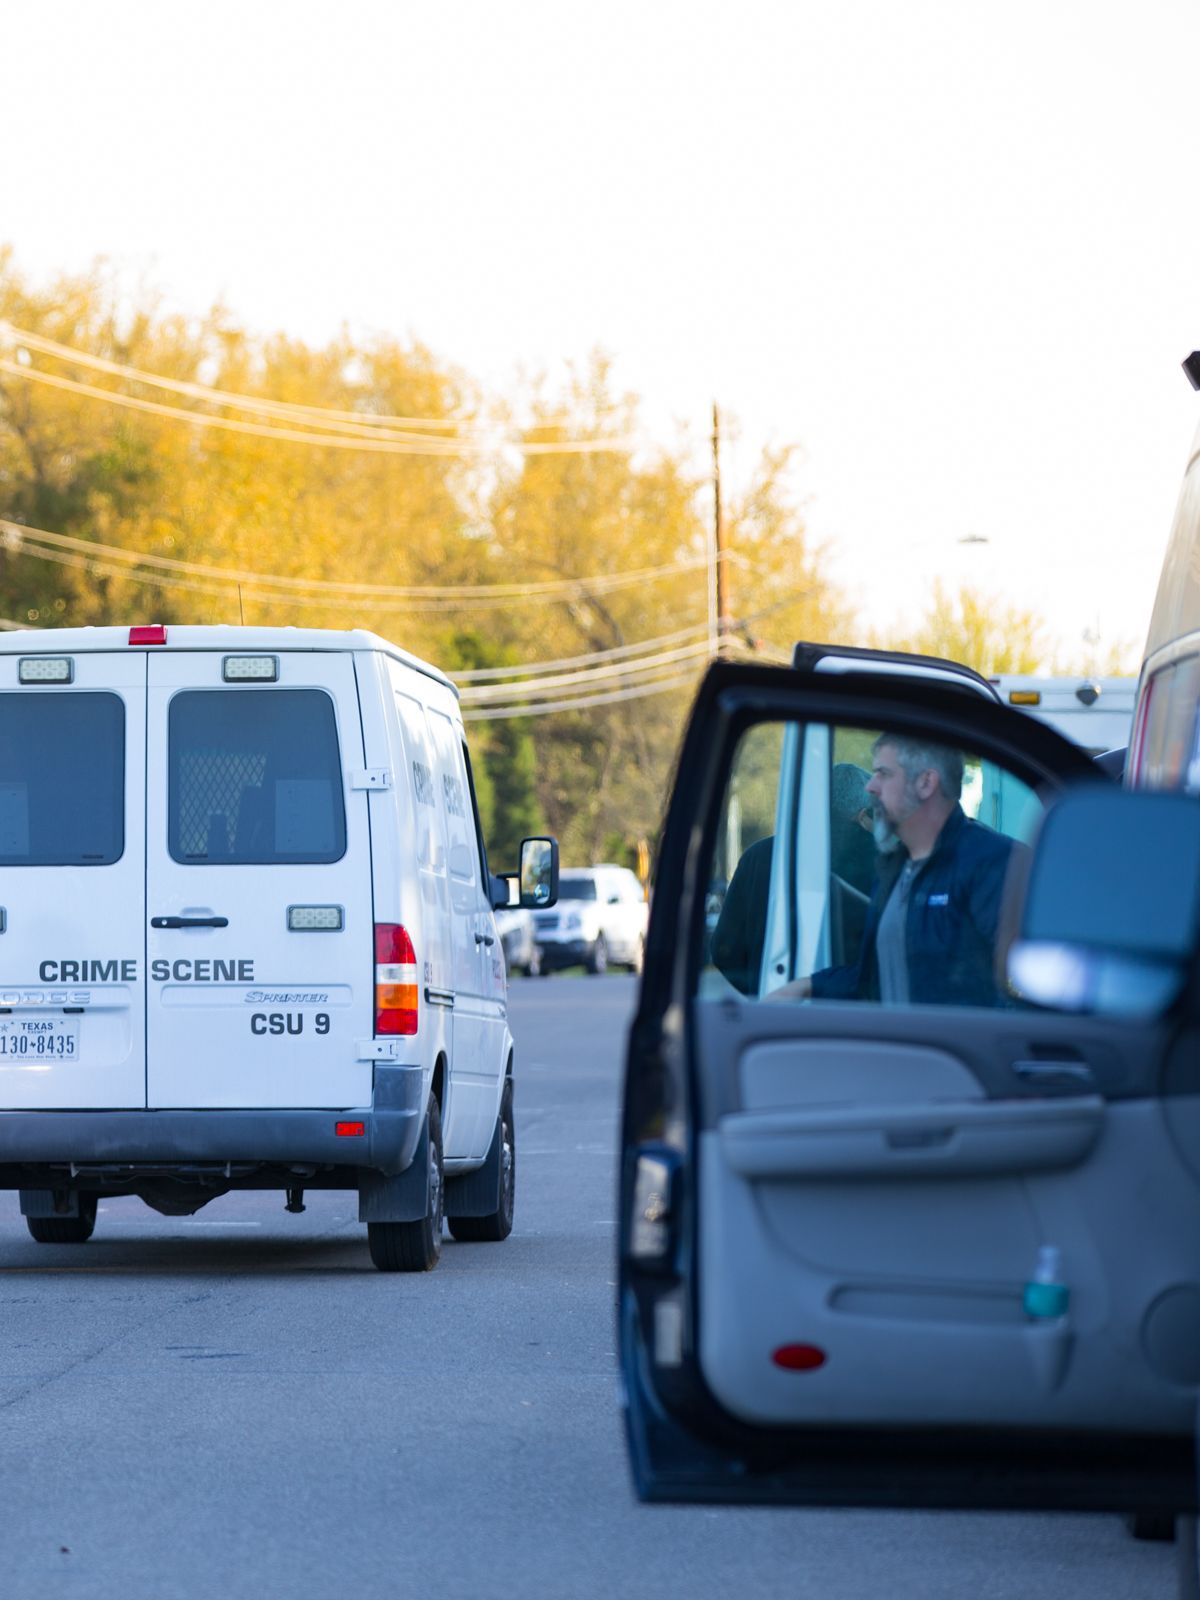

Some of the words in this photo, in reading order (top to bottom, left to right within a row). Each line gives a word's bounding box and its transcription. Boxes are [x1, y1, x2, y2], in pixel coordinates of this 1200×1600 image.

[38, 959, 138, 983] CRIME
[151, 959, 255, 982] SCENE
[21, 1022, 54, 1031] TEXAS
[250, 1012, 304, 1036] CSU
[314, 1012, 331, 1035] 9
